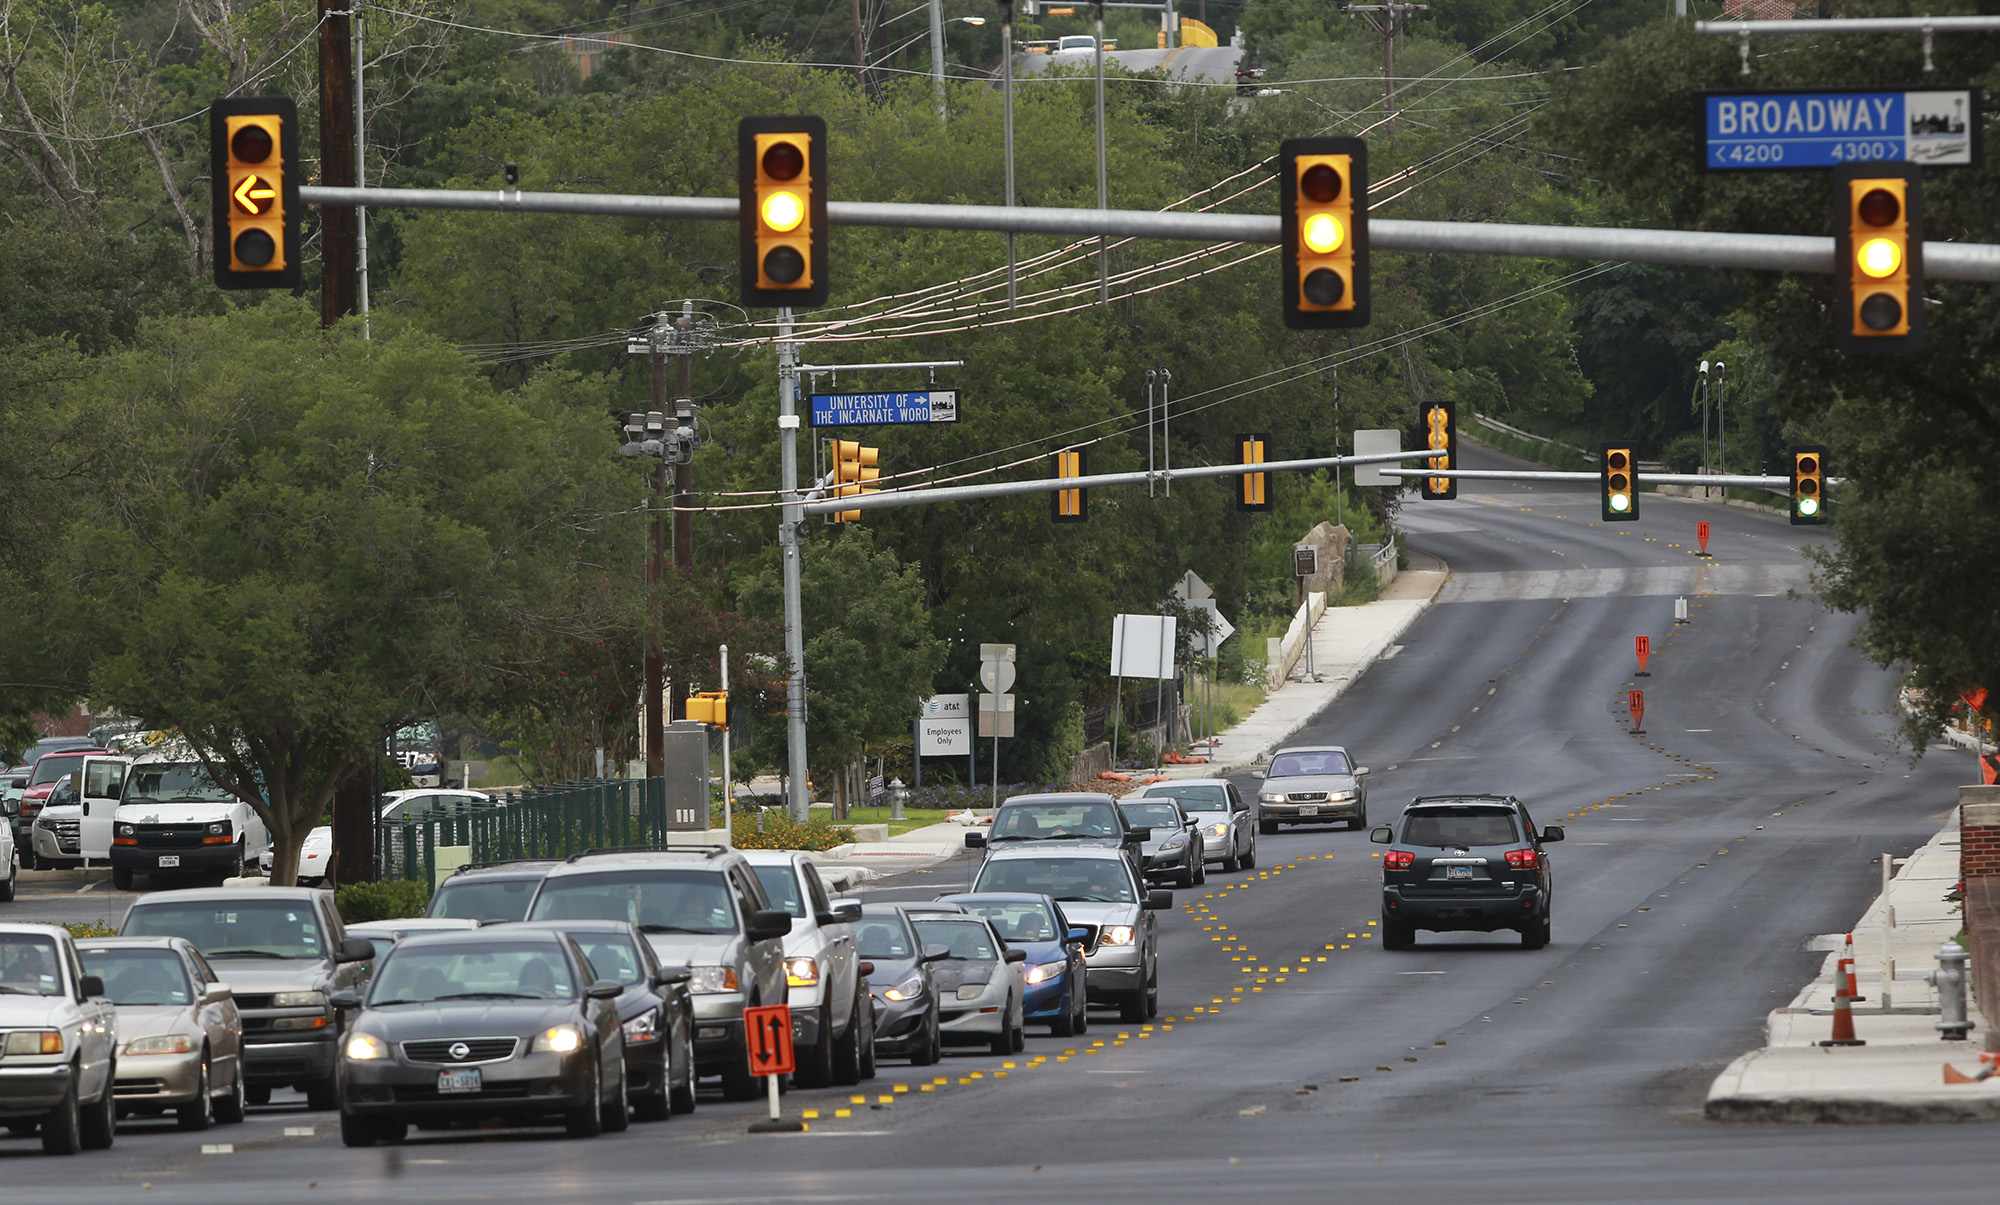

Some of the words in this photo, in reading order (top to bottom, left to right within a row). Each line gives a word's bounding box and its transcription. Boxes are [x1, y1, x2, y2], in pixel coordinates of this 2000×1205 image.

[1719, 99, 1893, 134] BROADWAY
[1729, 144, 1784, 162] 4200
[1831, 142, 1885, 160] 4300
[829, 395, 889, 410] UNIVERSITY
[896, 394, 908, 408] OF
[815, 411, 834, 424] THE
[839, 408, 894, 423] INCARNATE
[899, 408, 929, 422] WORD
[927, 728, 962, 737] Employees
[937, 737, 953, 745] Only
